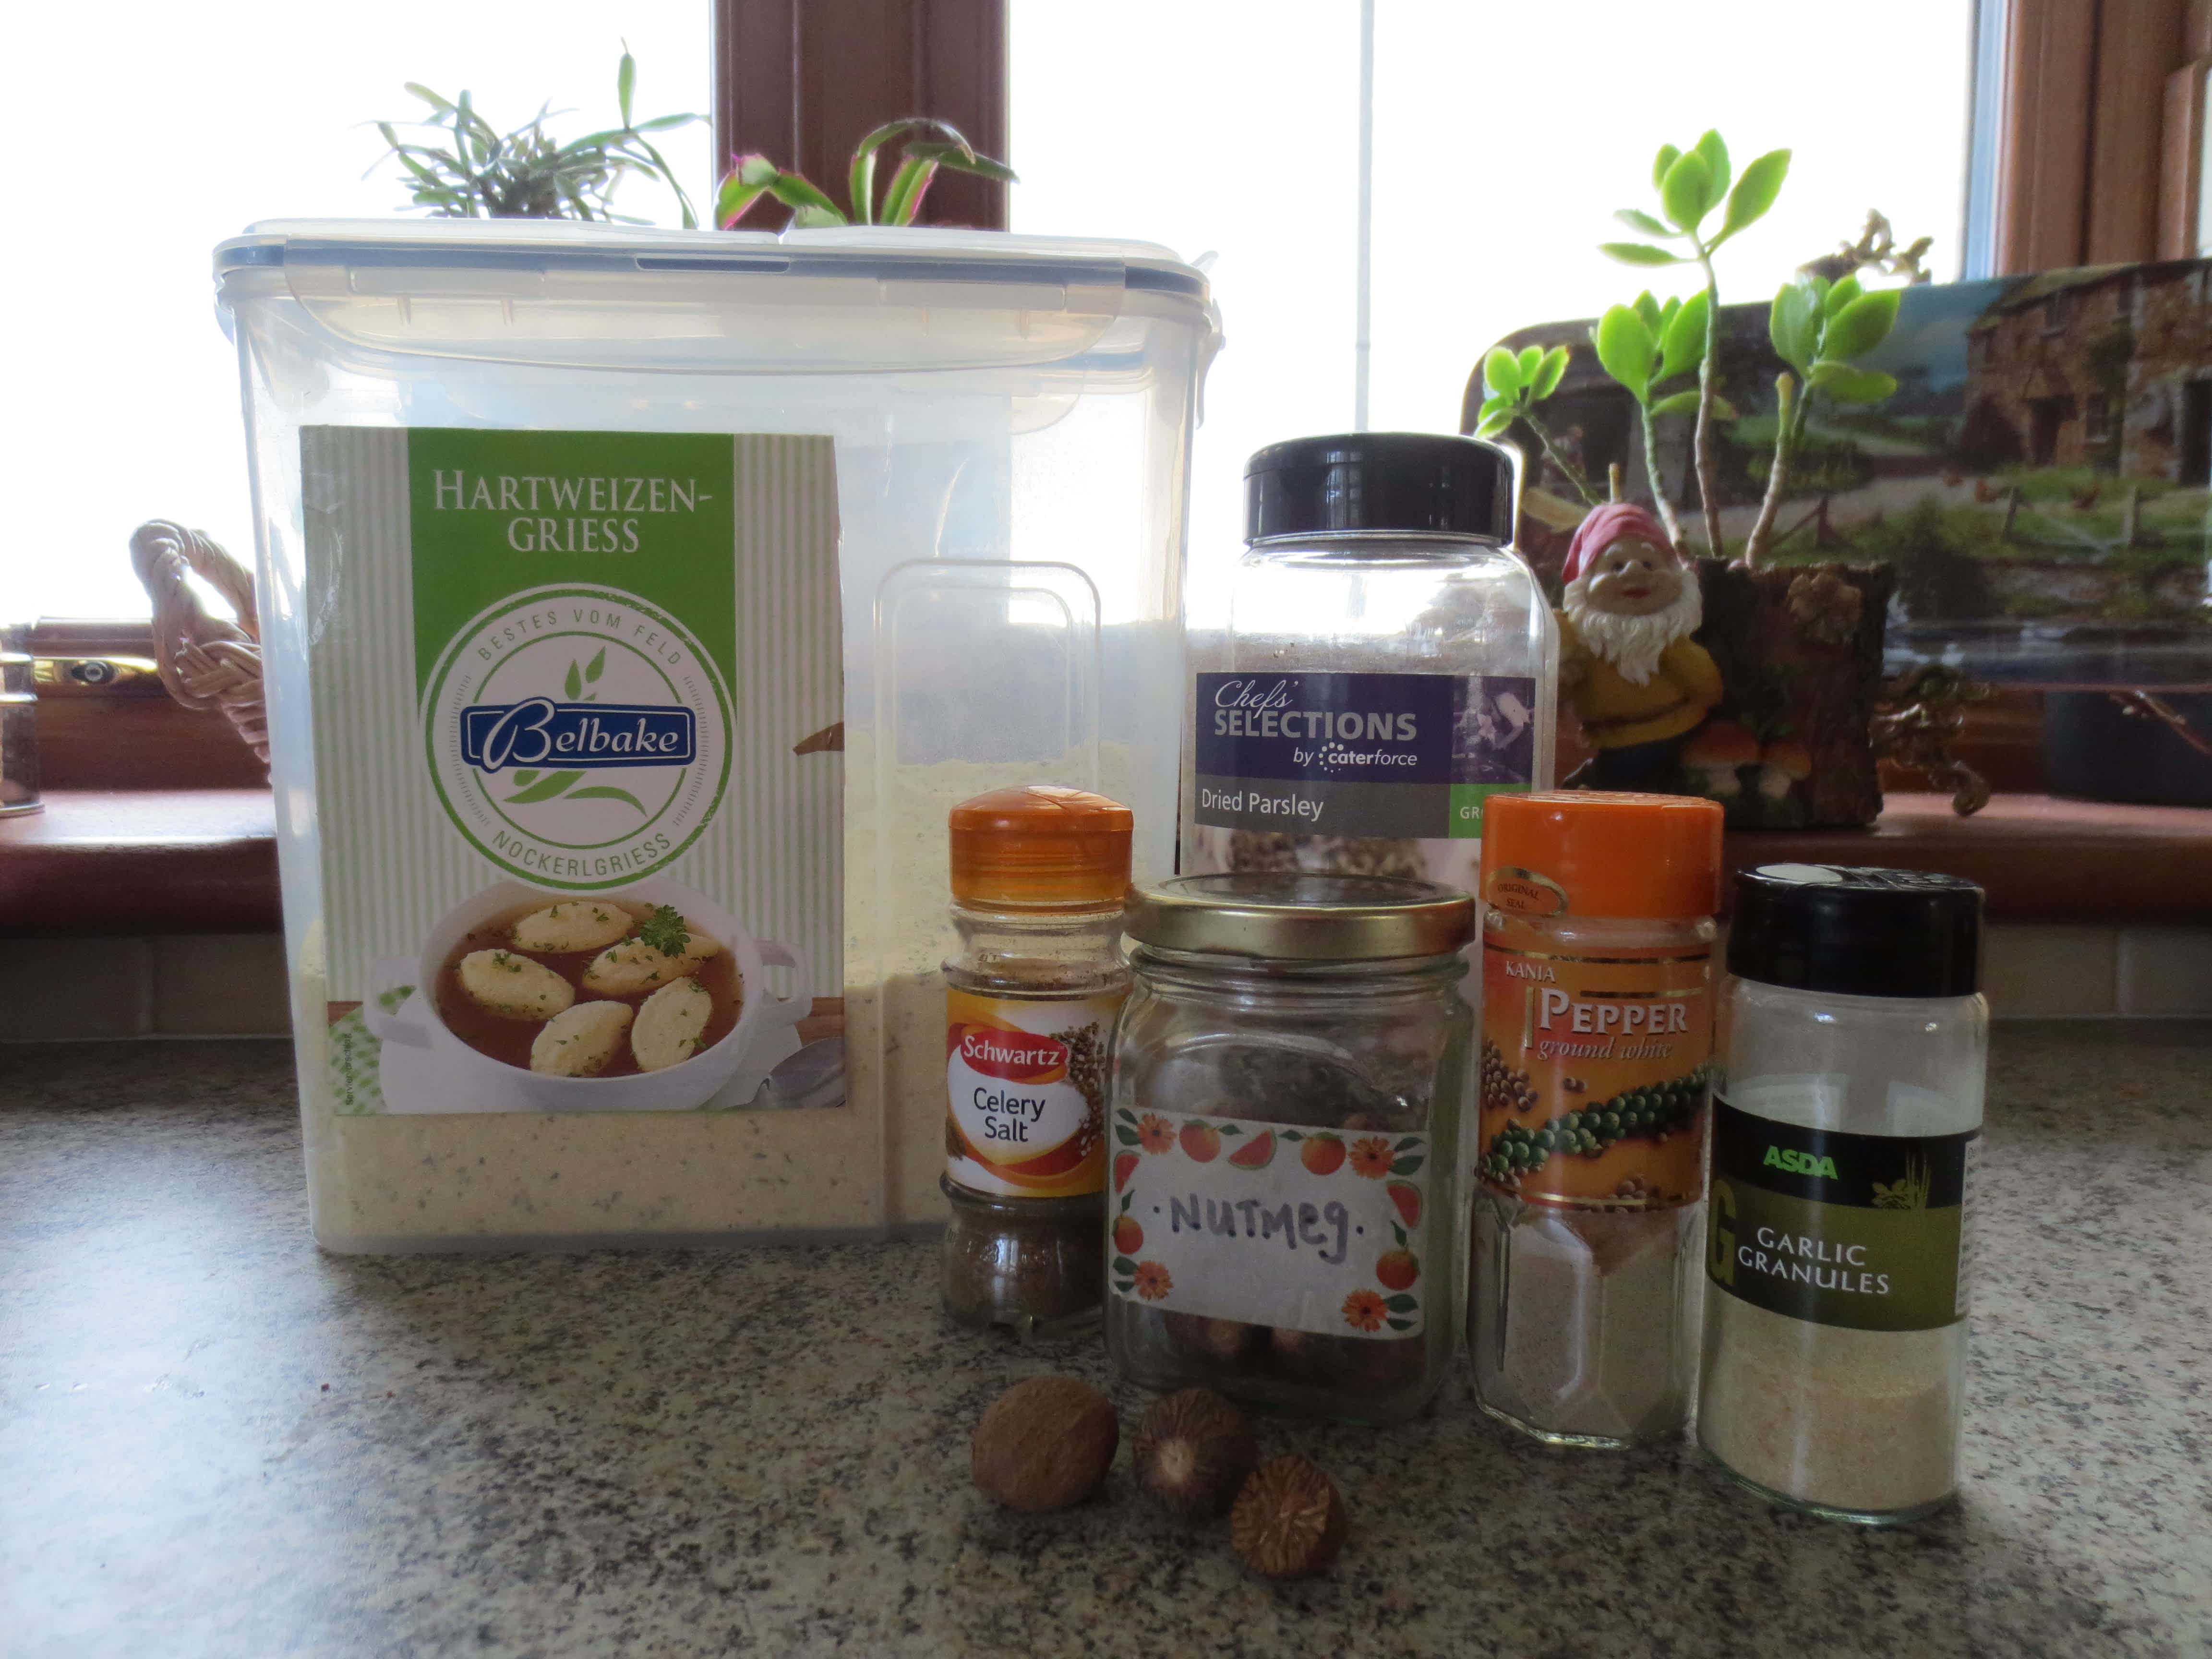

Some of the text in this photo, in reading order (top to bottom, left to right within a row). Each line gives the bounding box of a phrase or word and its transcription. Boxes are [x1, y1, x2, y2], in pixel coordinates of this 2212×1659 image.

[434, 469, 713, 513] HARTWEIZEN-
[507, 517, 639, 552] GRIESS
[478, 609, 681, 664] BESTES VOM FELD
[483, 701, 679, 768] Belbake
[1214, 709, 1417, 741] SELECTIONS
[1293, 747, 1418, 767] by caterforce
[1202, 789, 1324, 822] Dried Parsley
[1460, 806, 1483, 819] GR
[493, 830, 671, 876] NOCKERLGRIESS
[1497, 883, 1539, 901] ORIGINAL
[1506, 898, 1525, 910] SEAL
[1505, 961, 1556, 983] KANIA
[1539, 987, 1689, 1035] PEPPER
[963, 1035, 1060, 1066] Schwartz
[1537, 1036, 1672, 1060] ground white
[974, 1087, 1046, 1122] Celery
[984, 1116, 1029, 1142] Salt
[1763, 1145, 1839, 1179] ASDA
[1757, 1227, 1867, 1266] GARLIC
[1737, 1246, 1890, 1296] GRANULES
